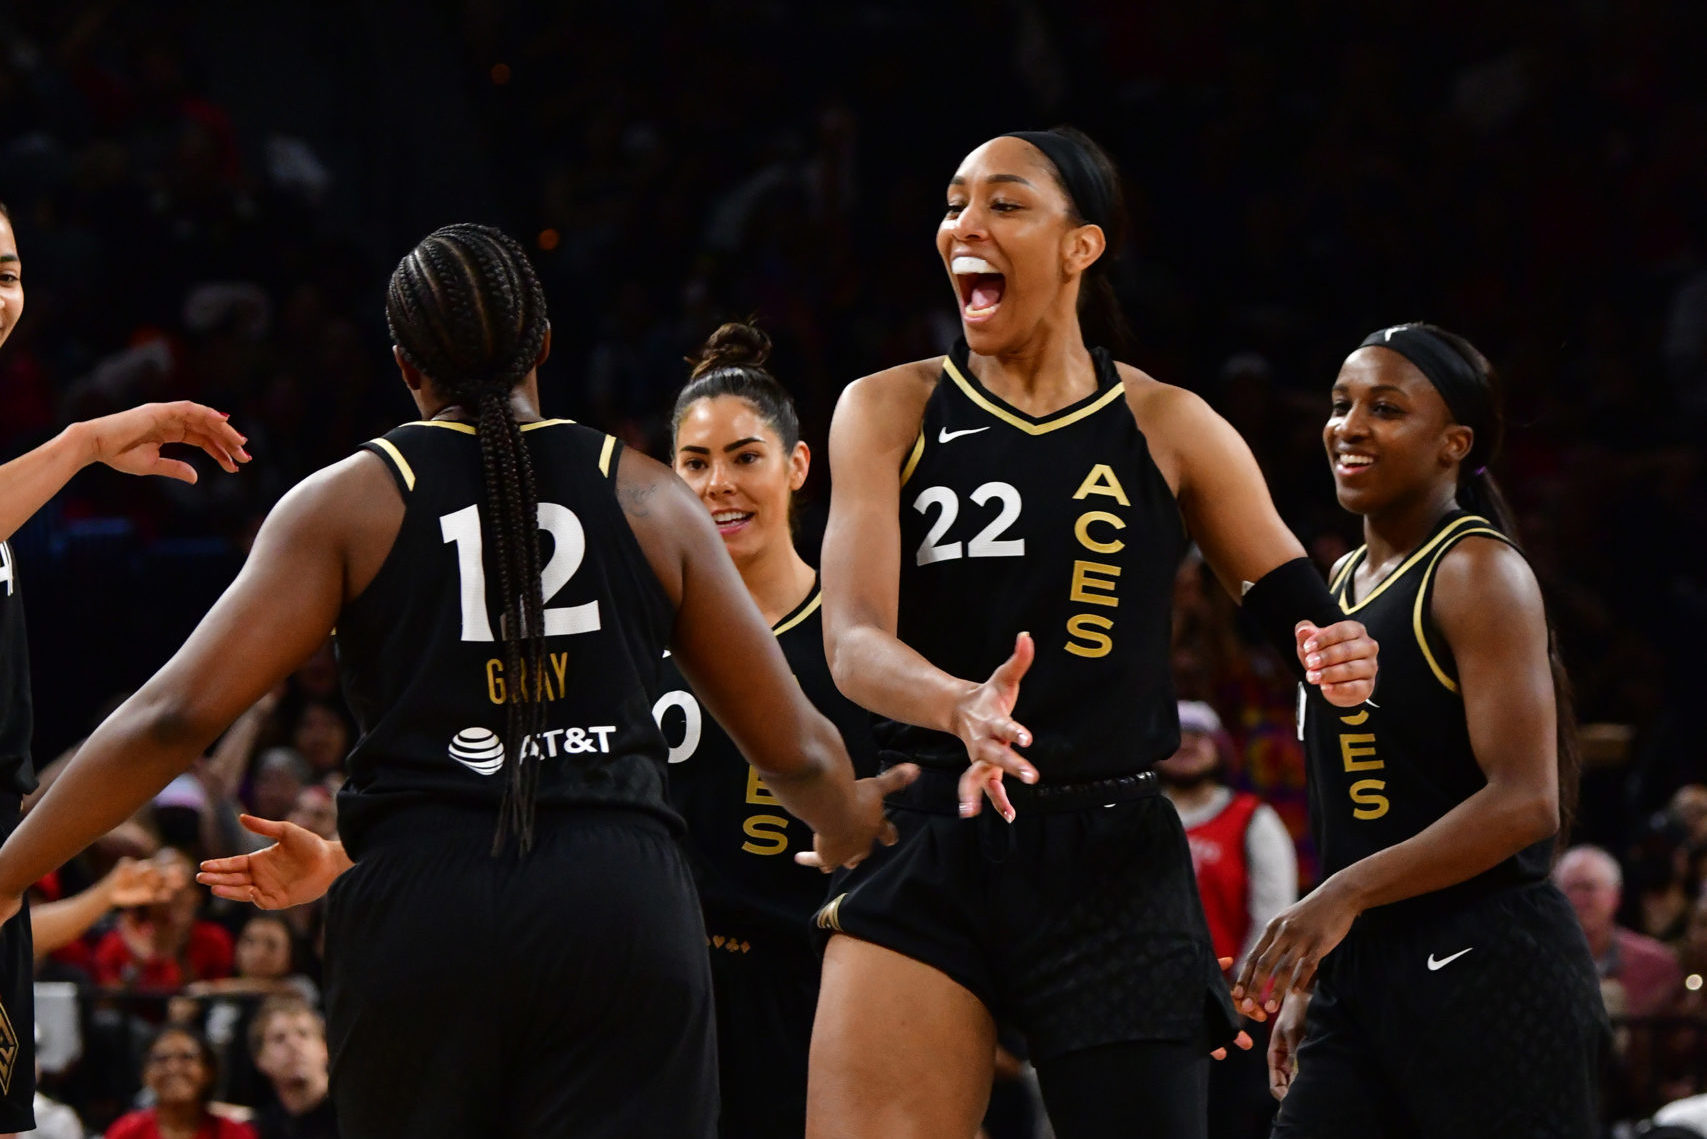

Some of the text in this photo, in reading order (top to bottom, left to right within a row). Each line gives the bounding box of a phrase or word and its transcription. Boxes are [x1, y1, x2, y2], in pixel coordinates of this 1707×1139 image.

[439, 502, 601, 642] 12
[912, 481, 1025, 567] 22
[1064, 463, 1131, 658] ACES
[518, 725, 617, 766] AT&T
